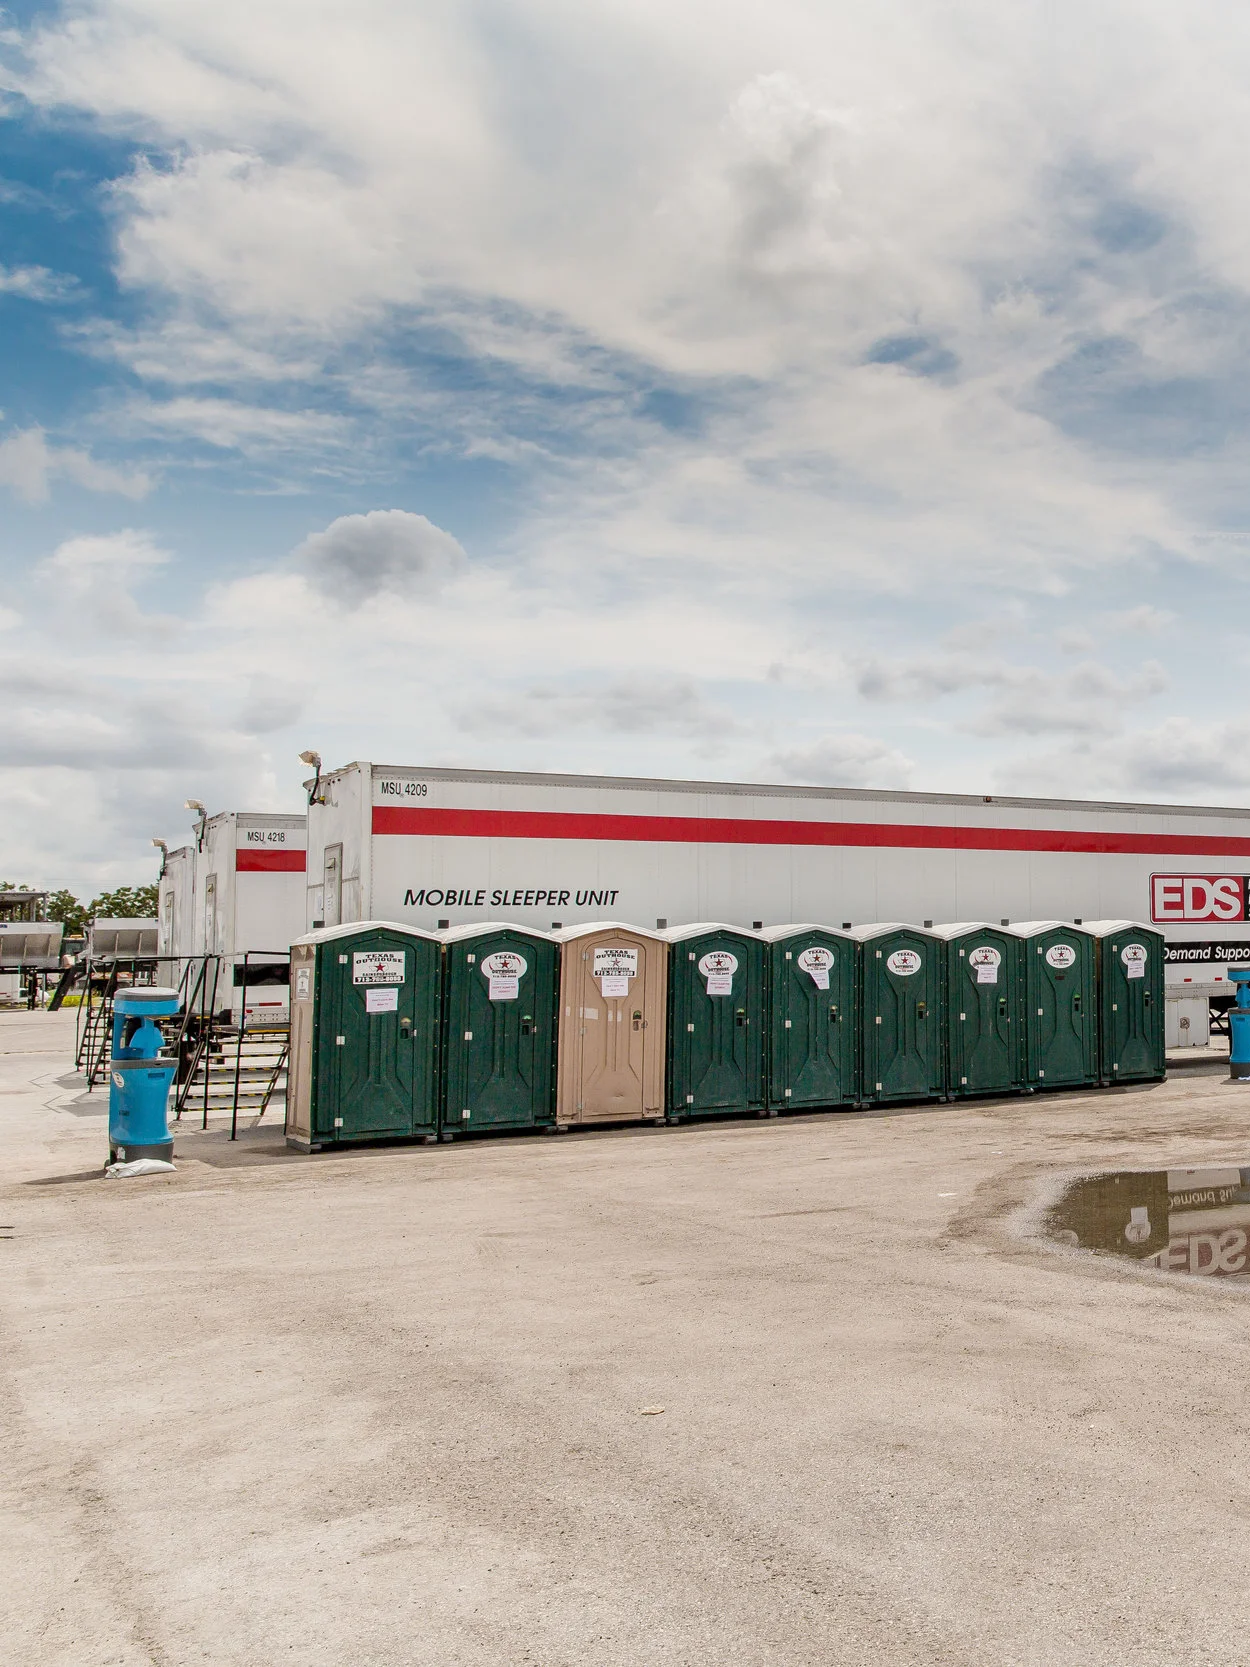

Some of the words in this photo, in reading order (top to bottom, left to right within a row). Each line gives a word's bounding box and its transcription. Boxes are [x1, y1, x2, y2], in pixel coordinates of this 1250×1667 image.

[381, 781, 401, 796] MSU
[404, 783, 428, 797] 4209
[247, 831, 264, 842] MSU
[267, 832, 285, 842] 4218
[404, 889, 487, 906] MOBILE
[490, 890, 571, 906] SLEEPER
[575, 890, 619, 906] UNIT
[1154, 878, 1242, 919] EDS
[356, 957, 404, 965] OUTHOUSE
